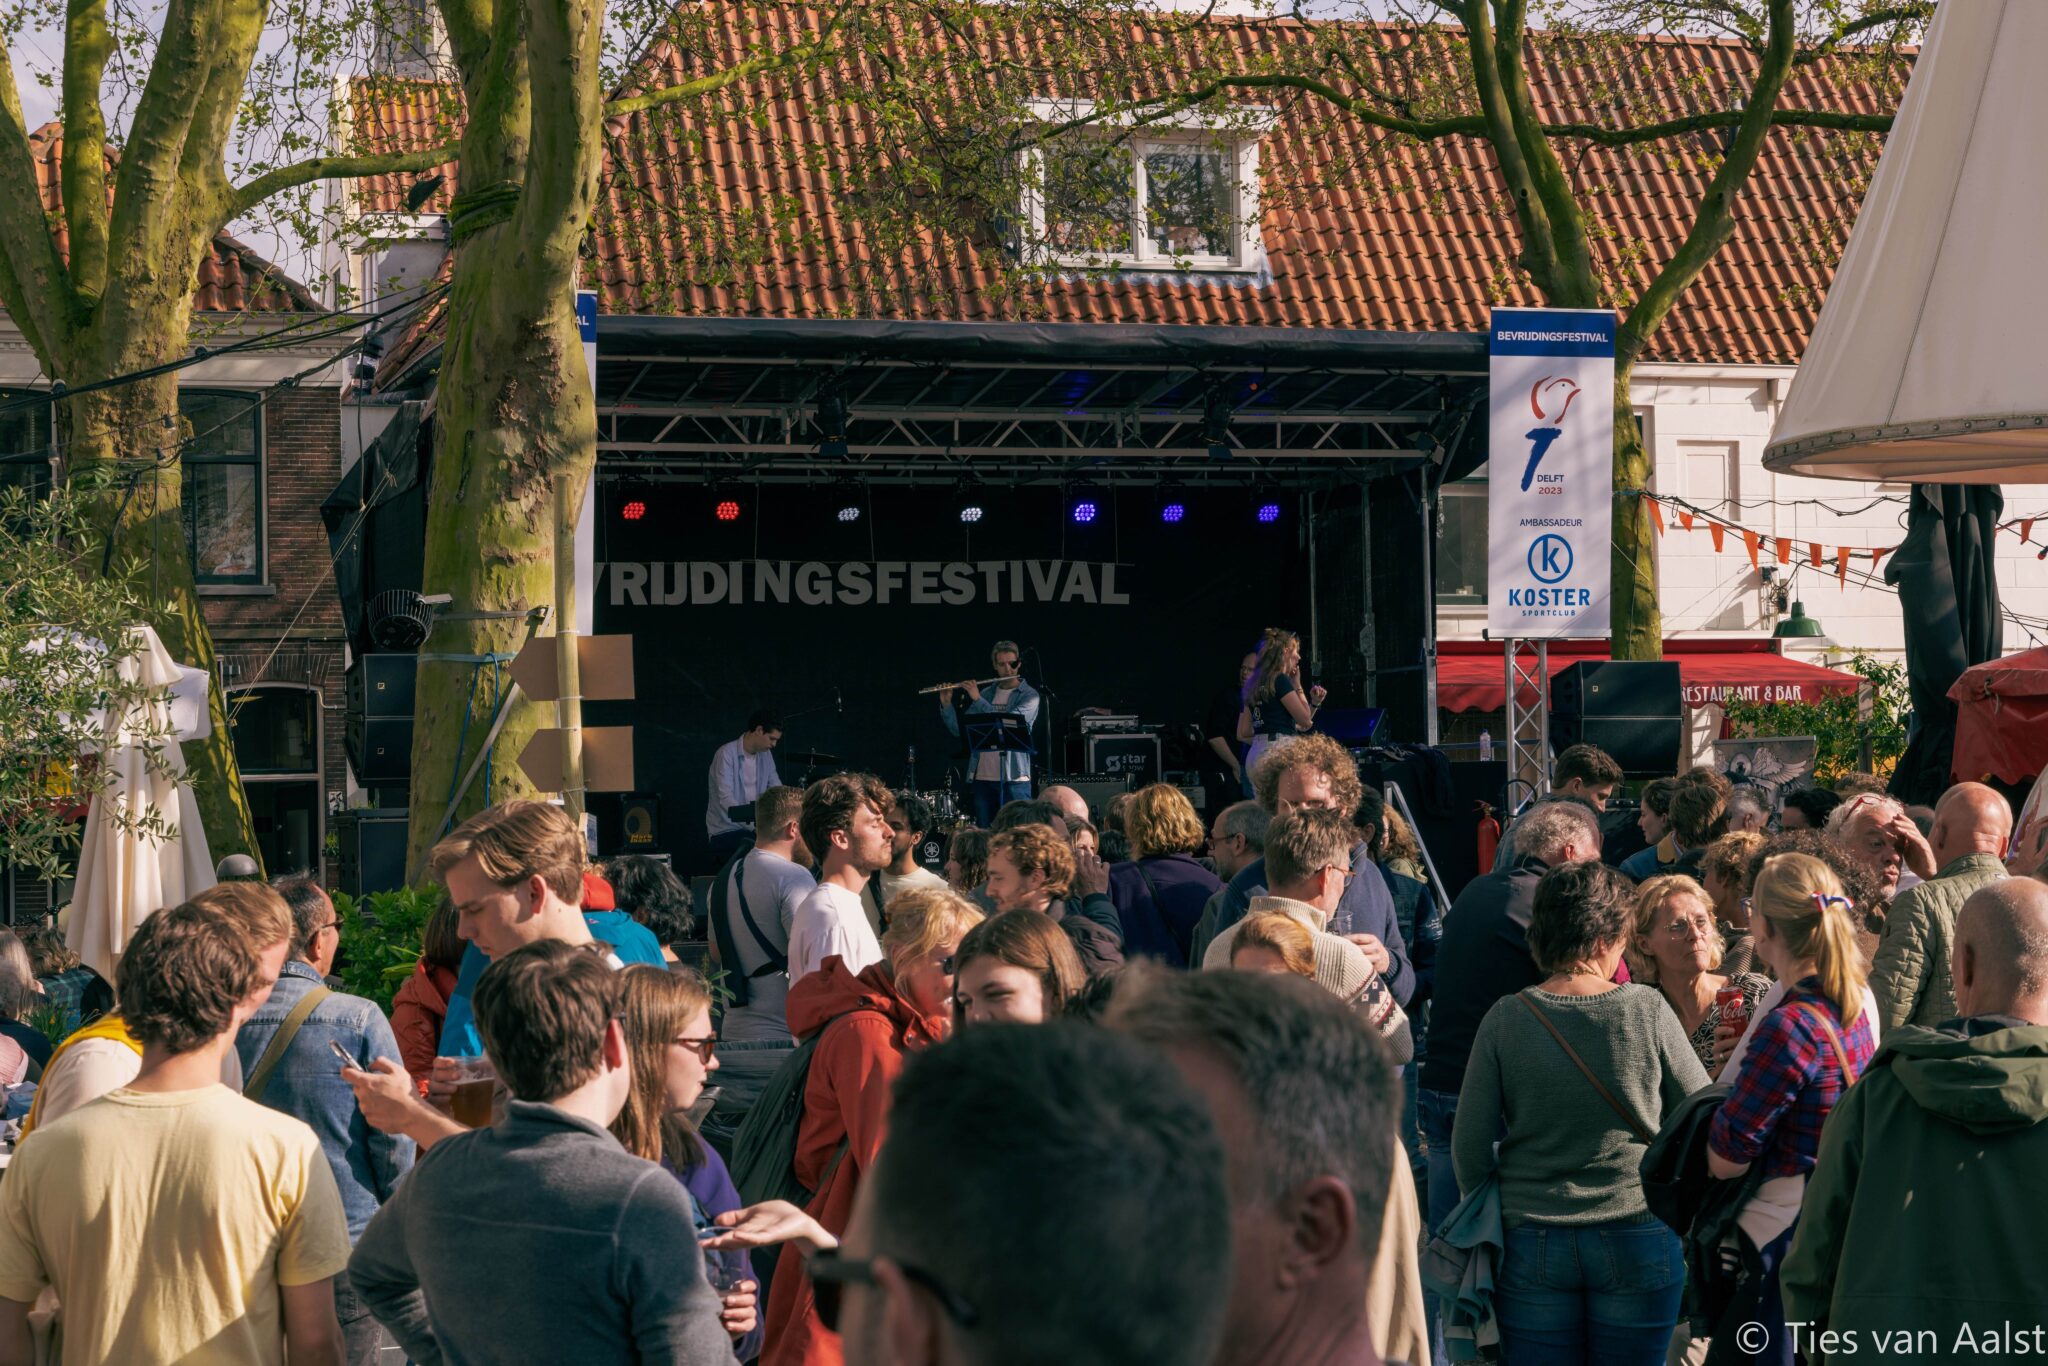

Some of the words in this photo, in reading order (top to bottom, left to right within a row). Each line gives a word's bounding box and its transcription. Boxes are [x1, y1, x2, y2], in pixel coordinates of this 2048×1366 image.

[1497, 331, 1608, 343] BEVRIJDINGSFESTIVAL
[1537, 474, 1564, 483] DELFT
[1538, 487, 1563, 495] 2023
[1519, 518, 1582, 527] AMBASSADEUR
[1508, 588, 1590, 607] KOSTER
[1522, 609, 1576, 617] SPORTCLUB
[1764, 686, 1772, 701] &
[1775, 685, 1802, 701] BAR
